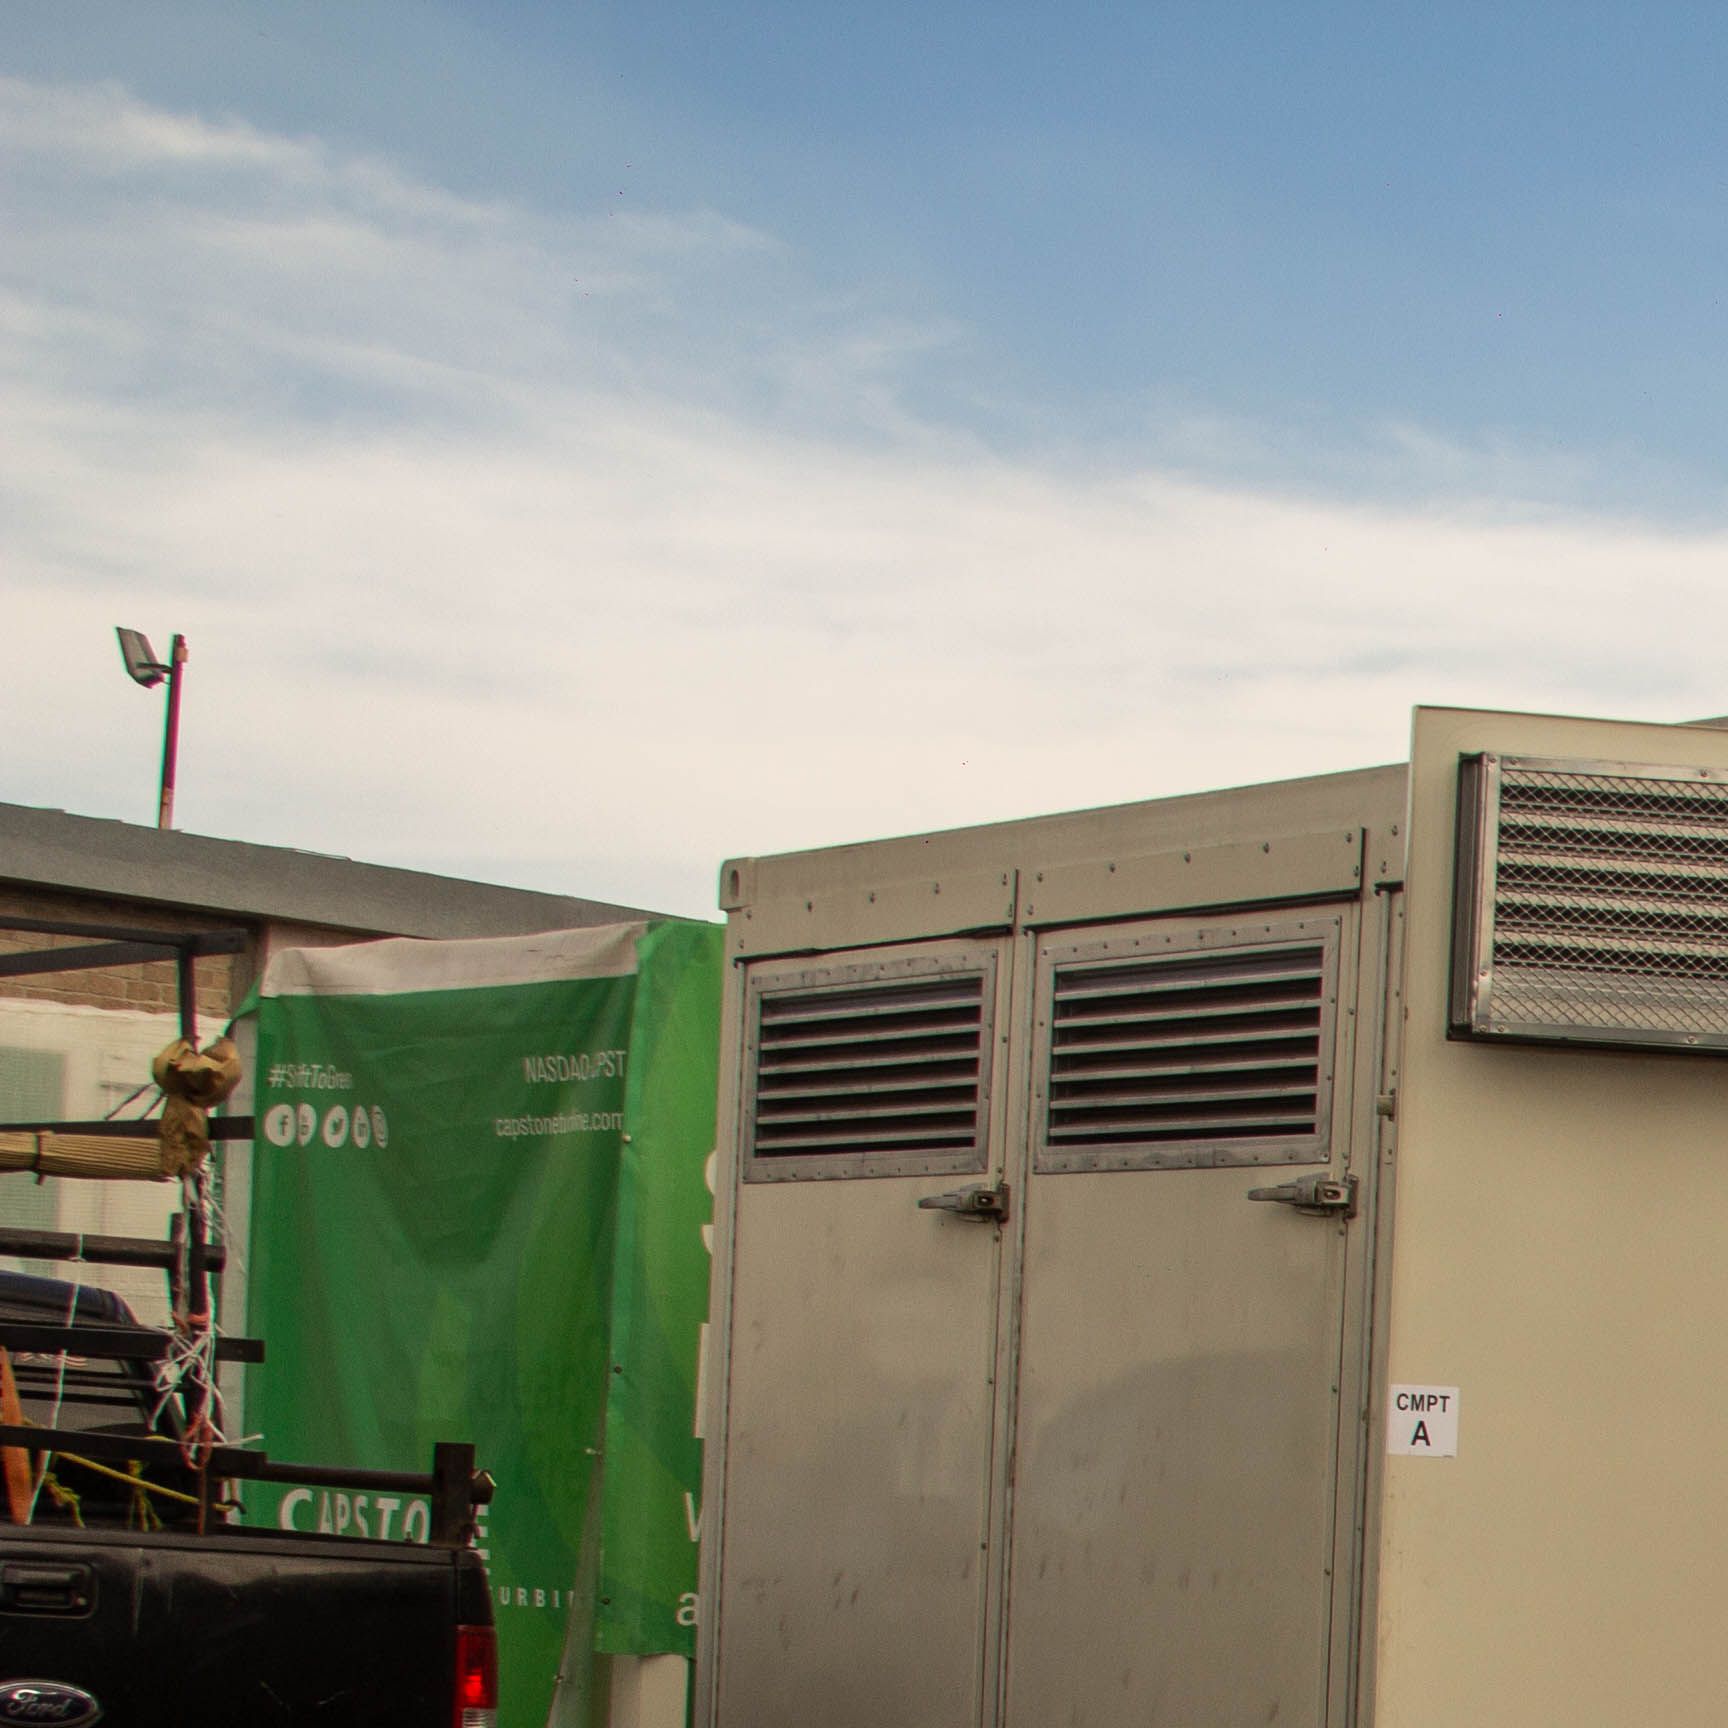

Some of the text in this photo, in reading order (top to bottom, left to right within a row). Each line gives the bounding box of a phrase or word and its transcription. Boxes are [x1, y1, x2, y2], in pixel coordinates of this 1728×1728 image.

[1396, 1392, 1451, 1413] CMPT
[1411, 1420, 1431, 1447] A
[7, 1689, 73, 1717] Ford
